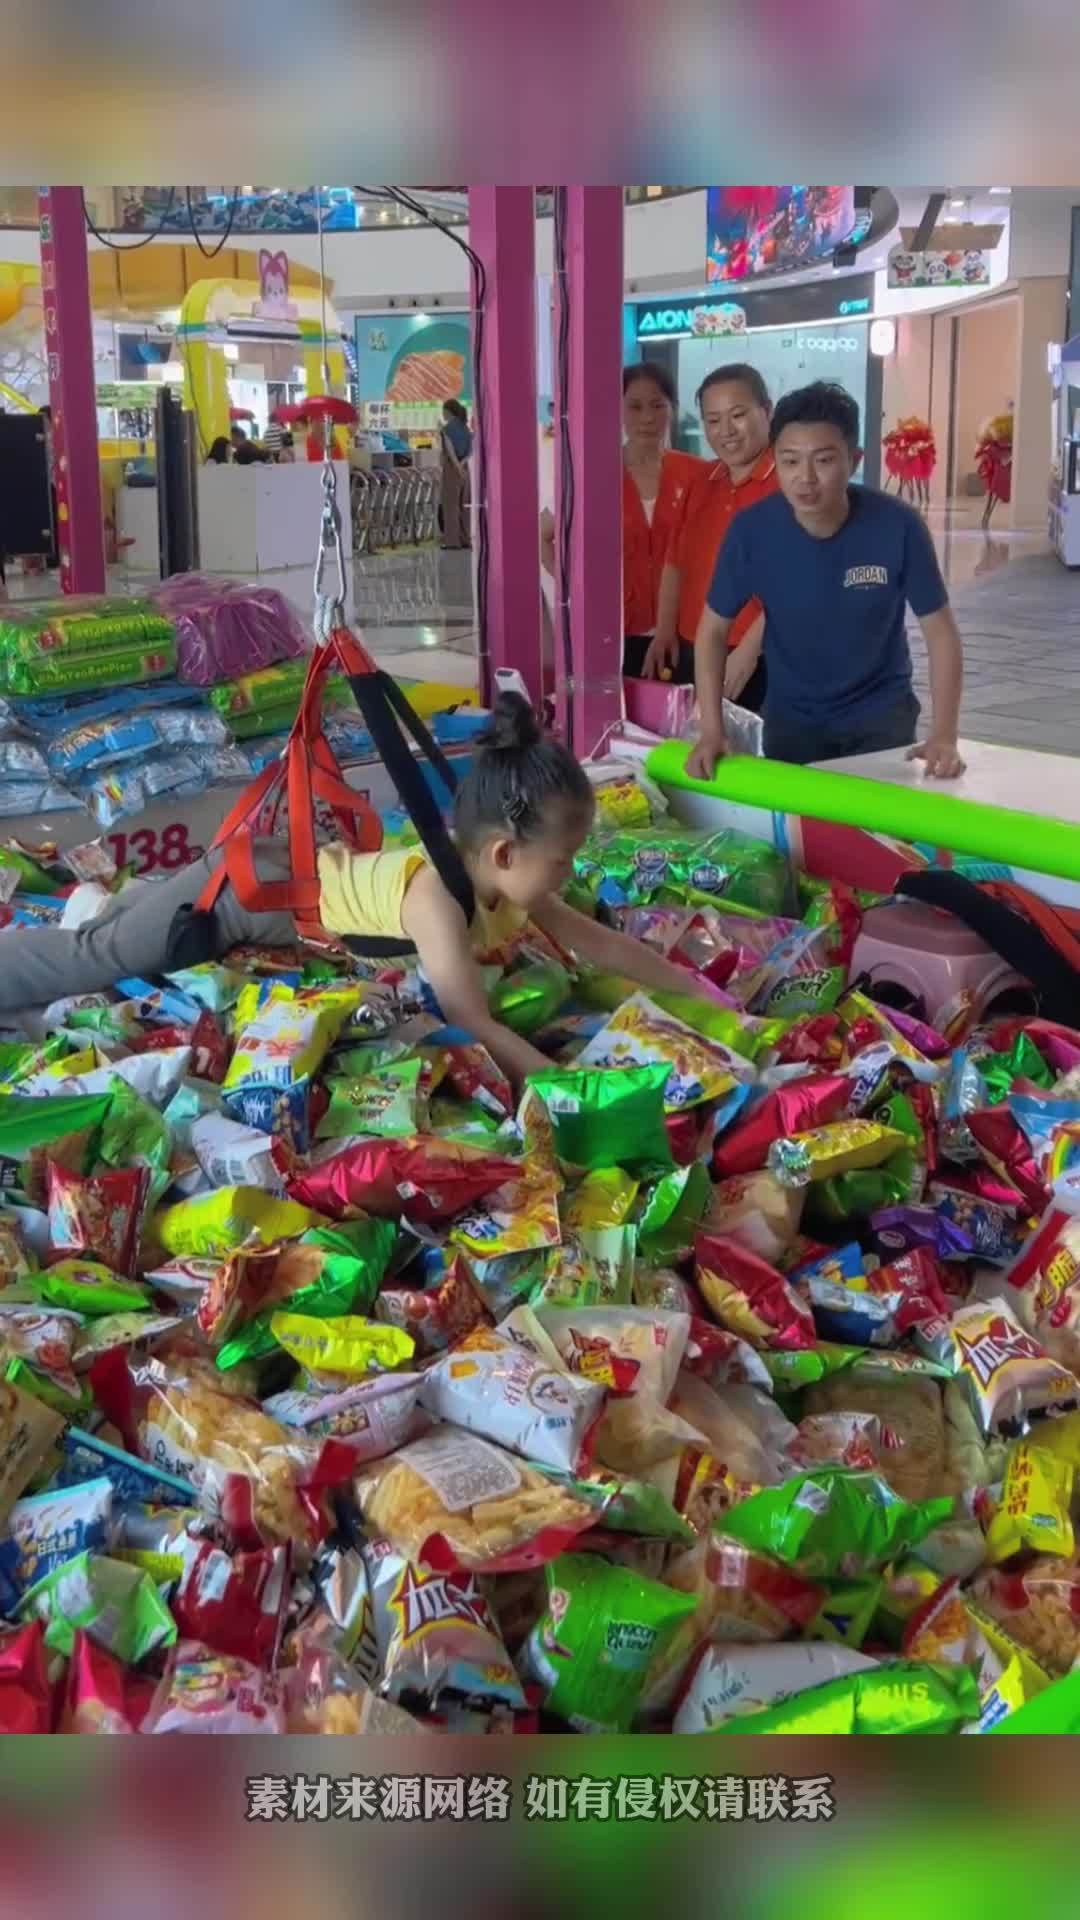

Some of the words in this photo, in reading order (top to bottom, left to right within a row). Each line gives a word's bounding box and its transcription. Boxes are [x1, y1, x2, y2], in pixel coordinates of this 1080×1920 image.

[639, 309, 693, 331] AION
[843, 565, 888, 587] JORDAN
[107, 823, 190, 875] 138
